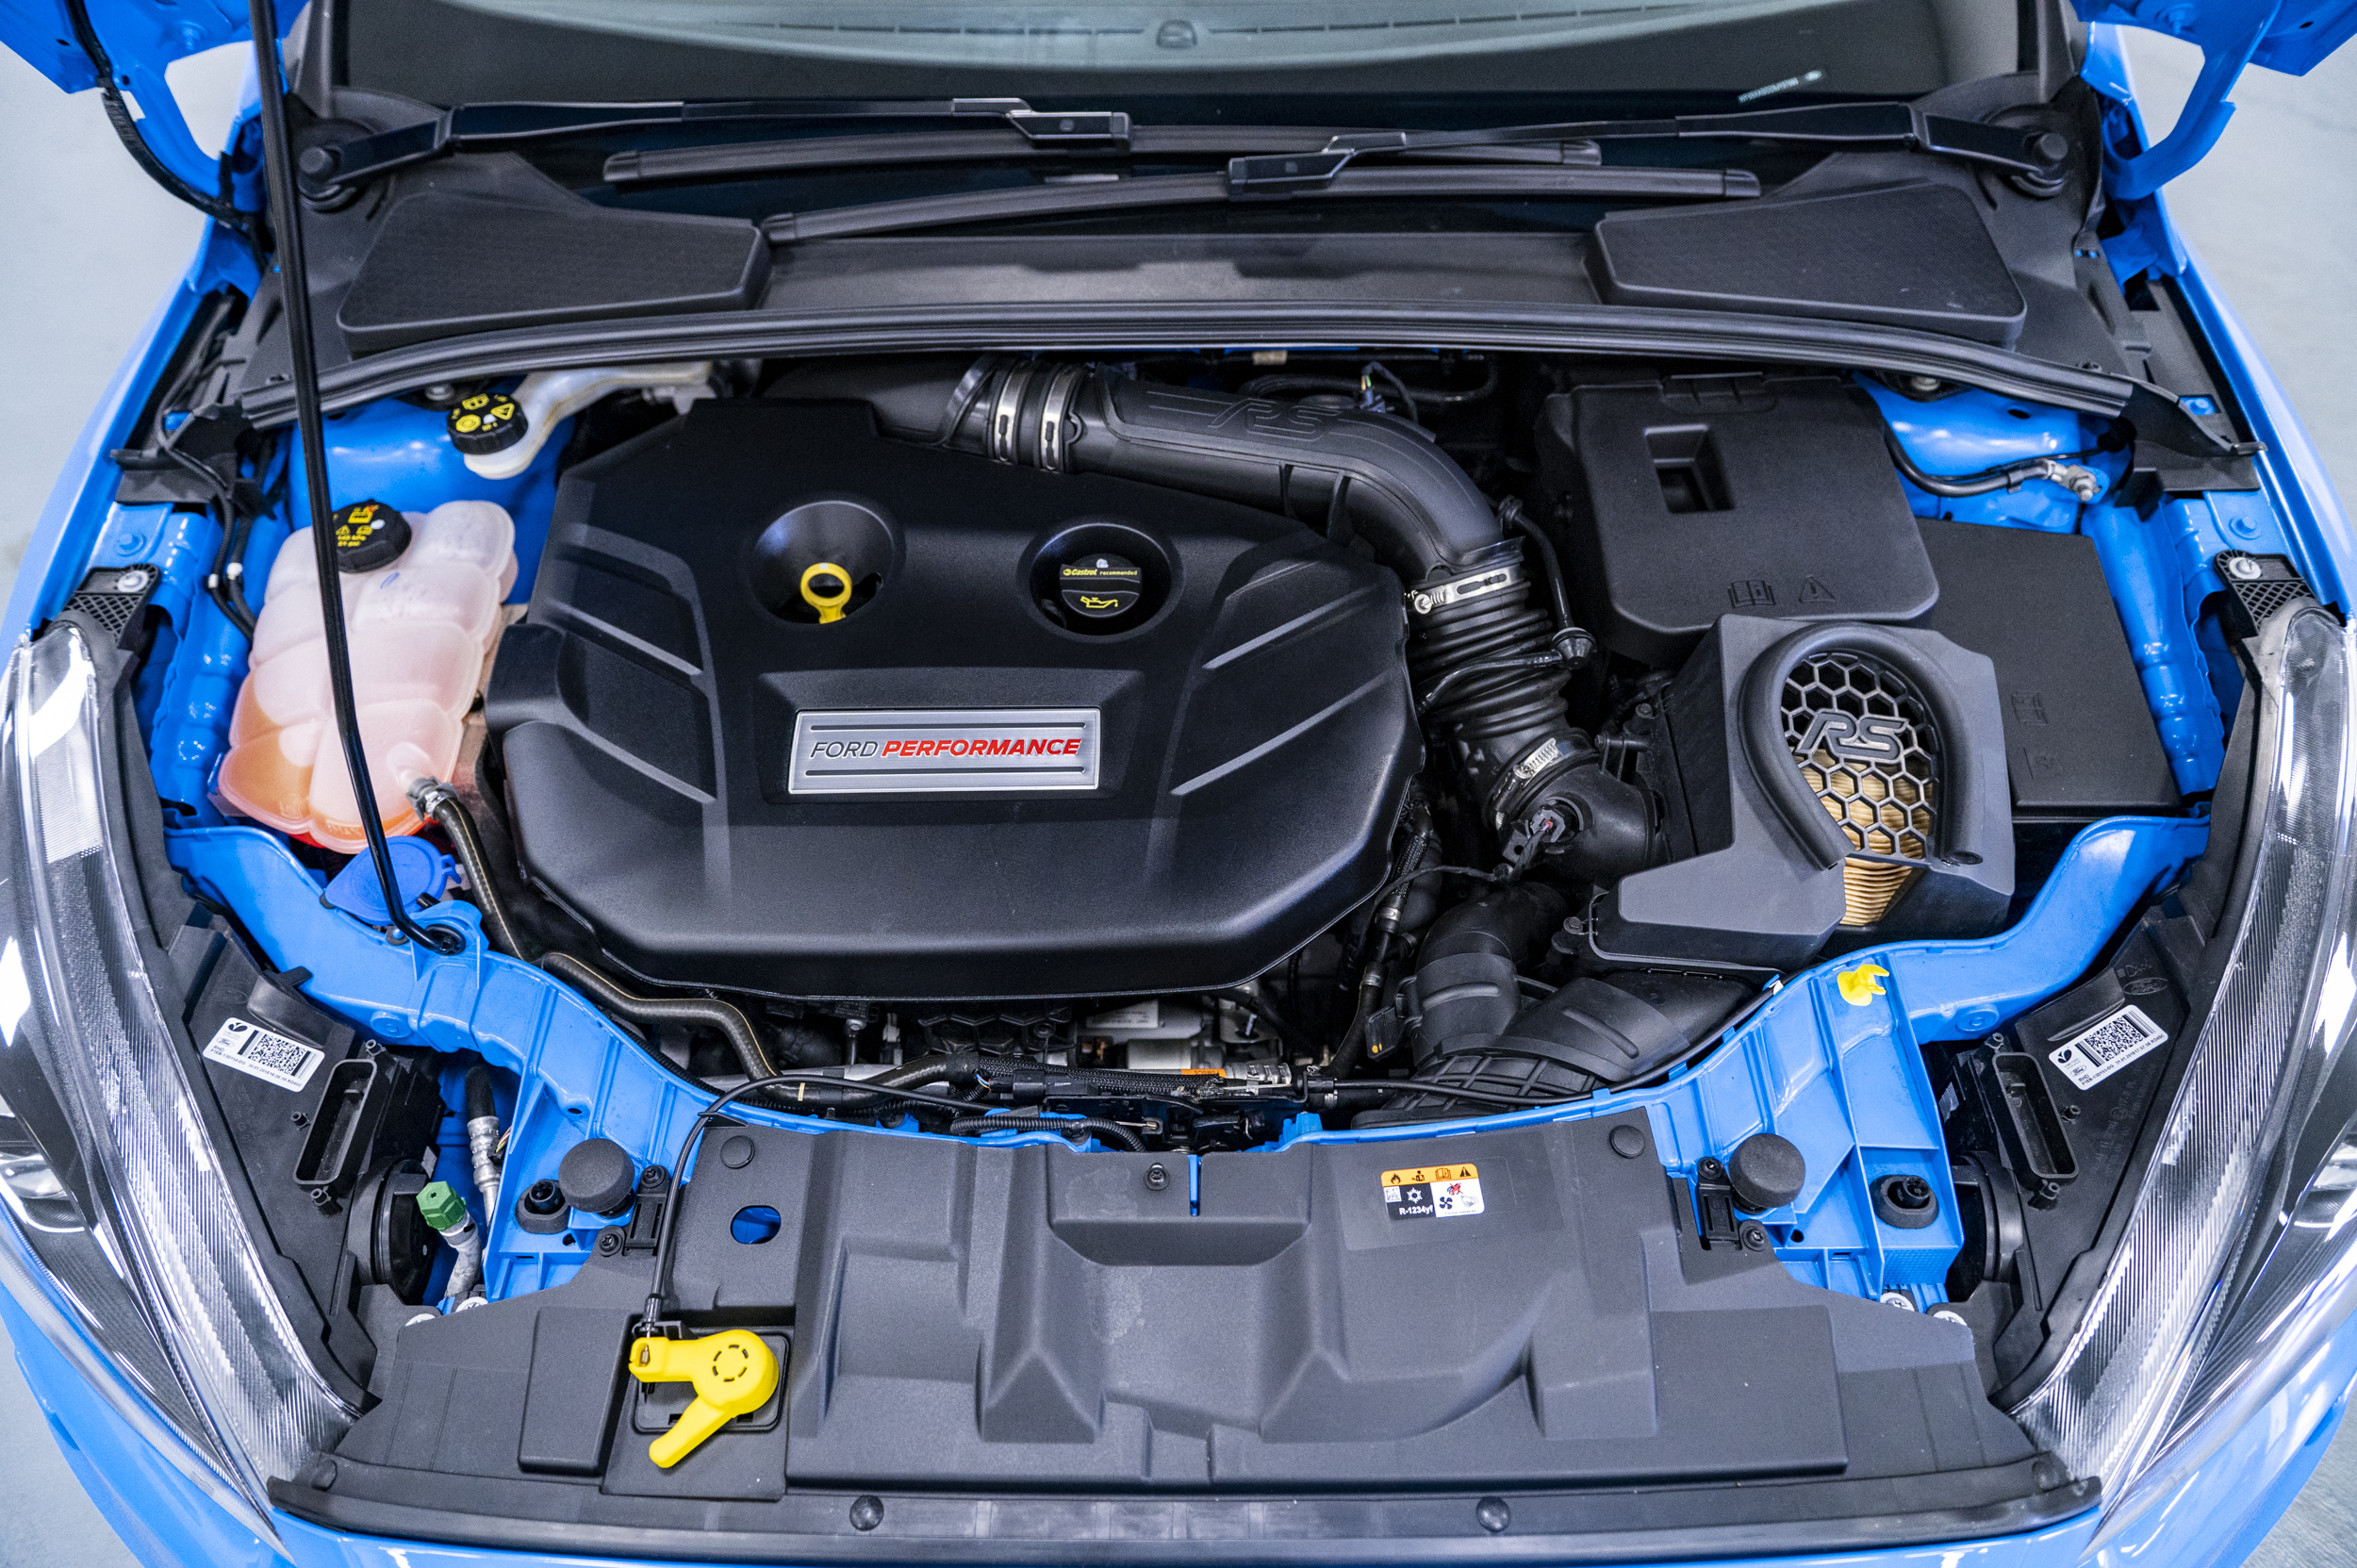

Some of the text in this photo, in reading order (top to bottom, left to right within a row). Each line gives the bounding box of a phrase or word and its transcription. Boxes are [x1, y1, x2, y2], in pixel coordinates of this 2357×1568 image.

[1793, 708, 1910, 764] RS
[810, 738, 1082, 759] FORD PERFORMANCE
[1399, 1205, 1433, 1215] R-1234yf
